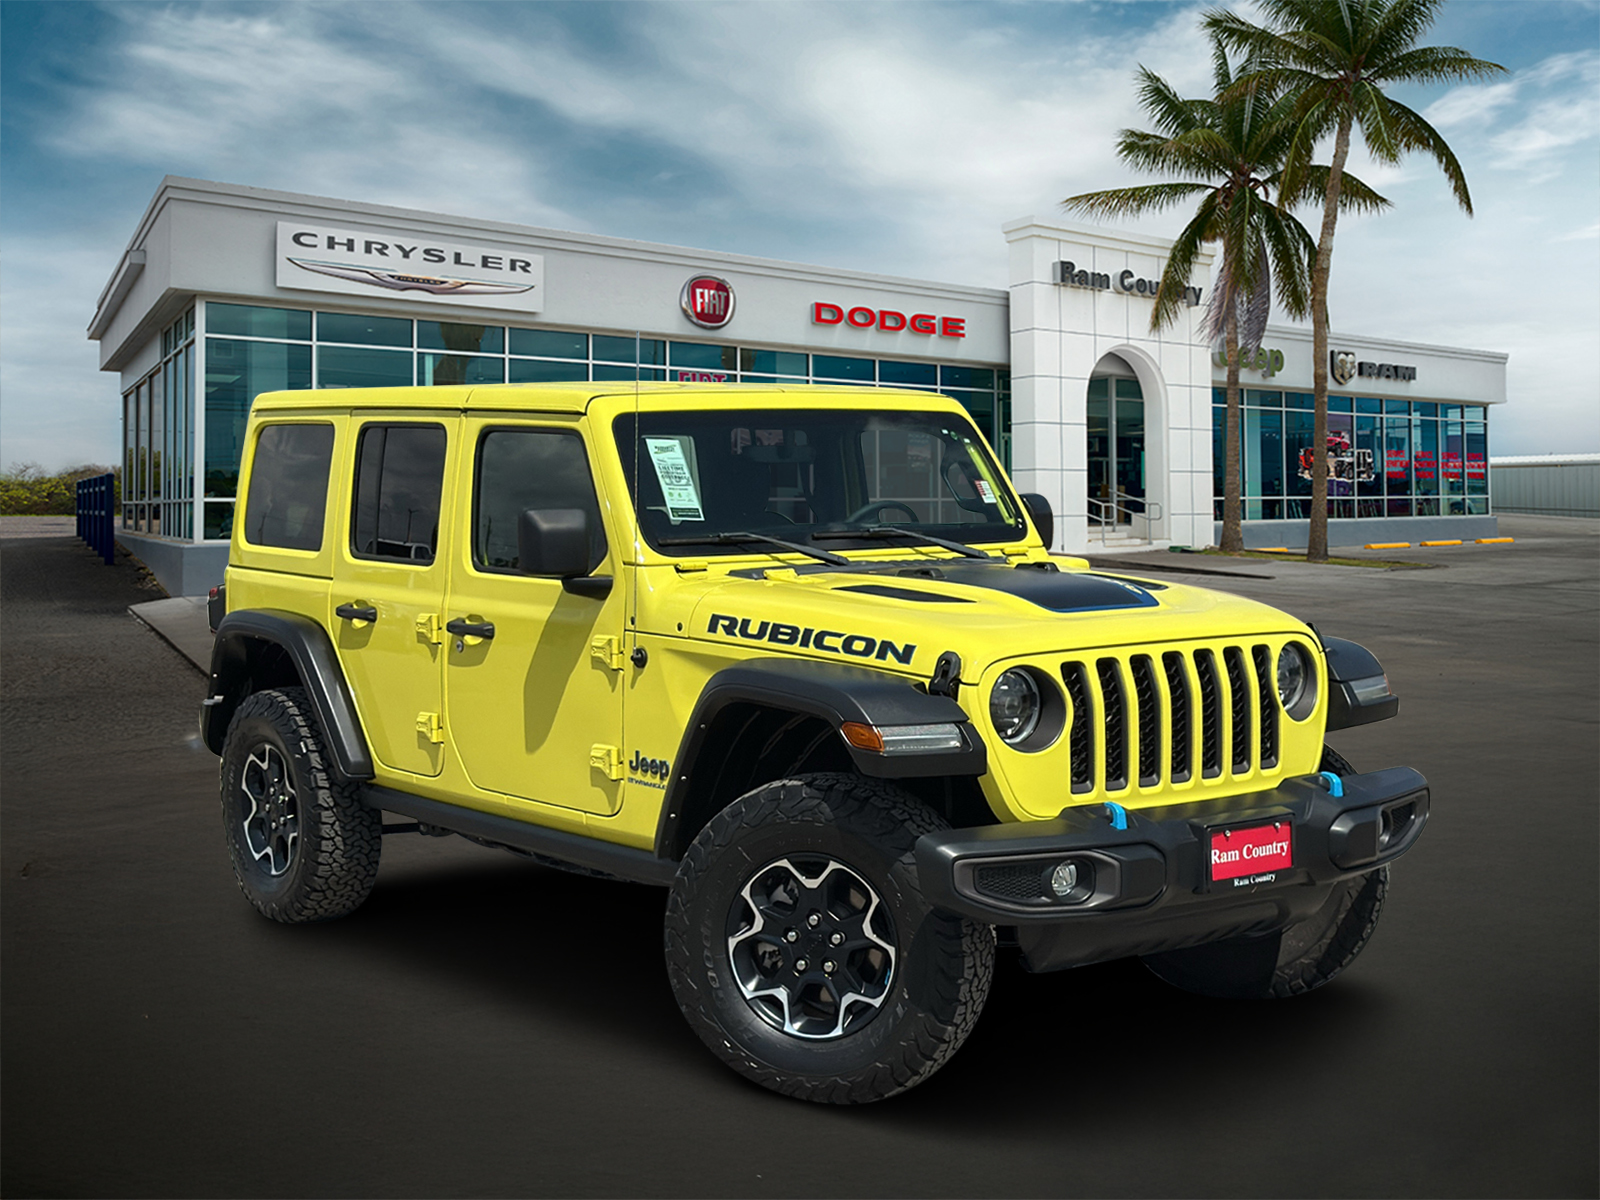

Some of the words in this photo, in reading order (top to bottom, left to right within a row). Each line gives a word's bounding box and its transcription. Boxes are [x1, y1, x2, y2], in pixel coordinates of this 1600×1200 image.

[291, 231, 533, 274] CHRYSLER
[1057, 260, 1110, 290] Ram
[695, 288, 728, 316] FIAT
[813, 301, 967, 338] DODGE
[1357, 361, 1417, 381] RAM
[707, 614, 917, 665] RUBICON
[629, 750, 670, 780] Jeep
[1211, 849, 1240, 865] Ram
[1242, 840, 1289, 859] Country
[1234, 877, 1250, 887] Ram
[1250, 872, 1277, 883] Country
